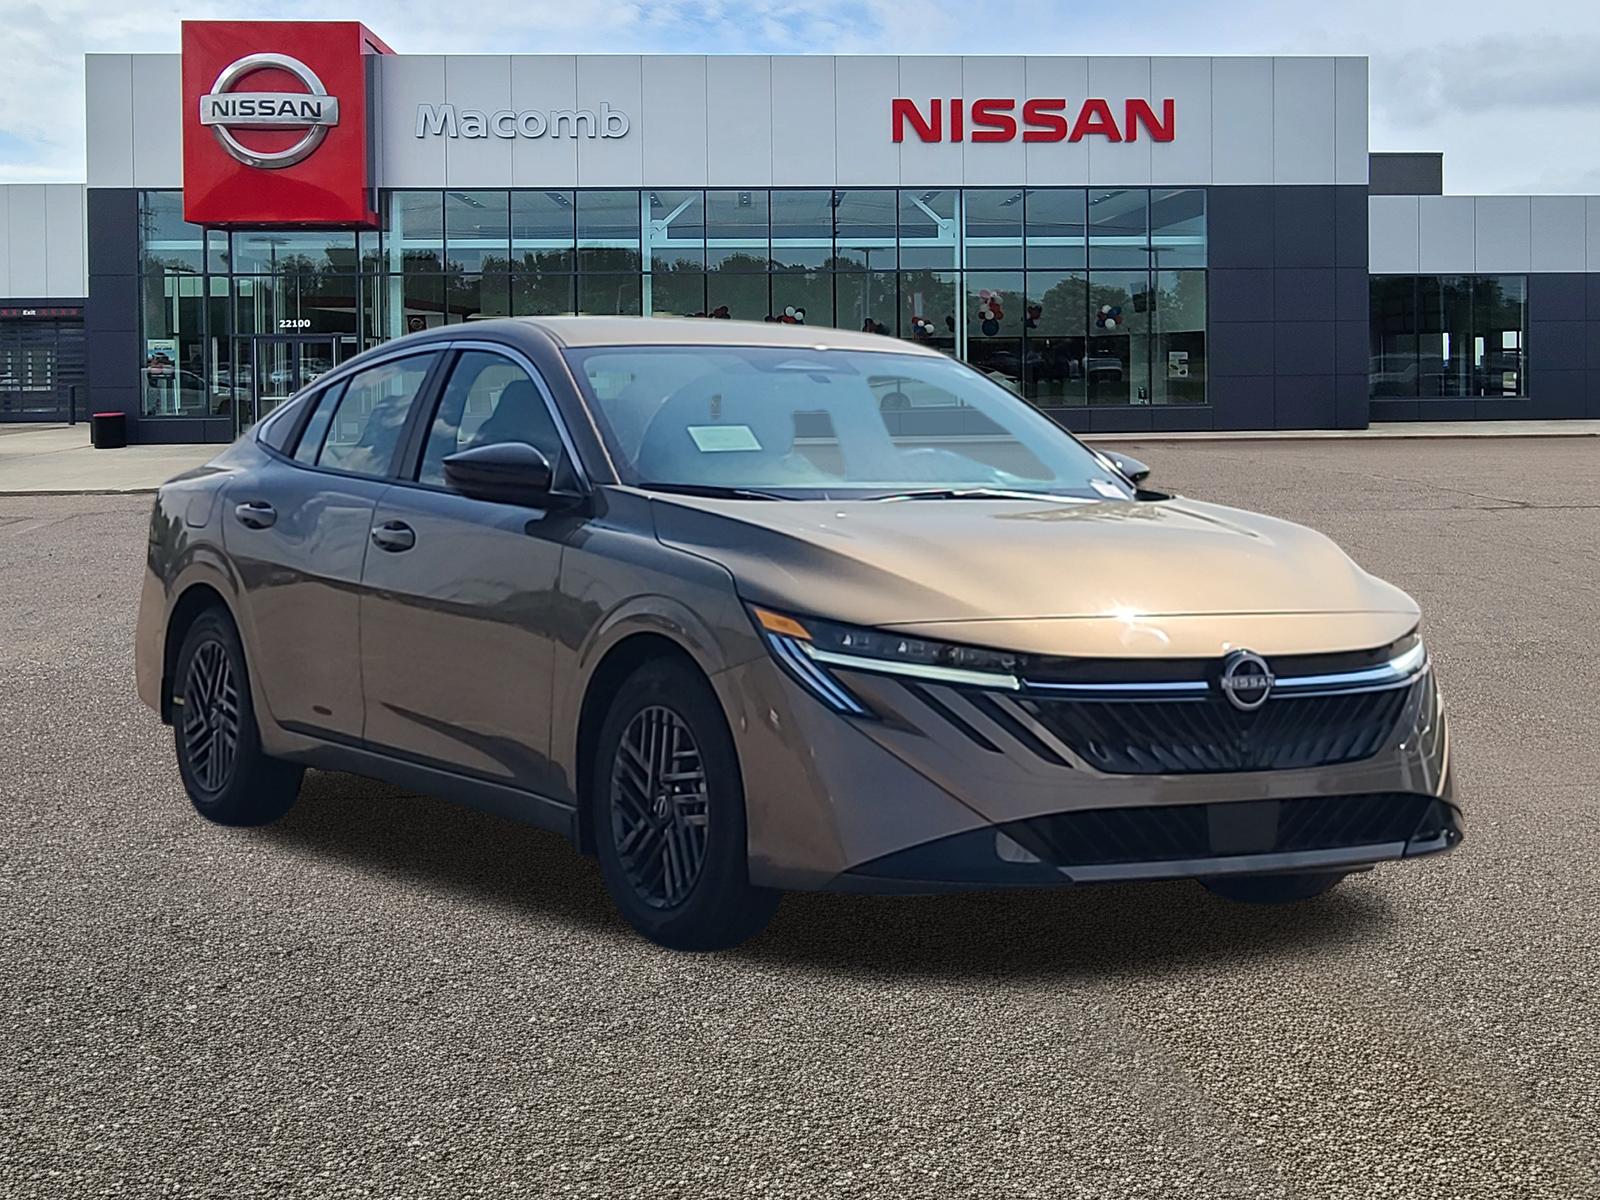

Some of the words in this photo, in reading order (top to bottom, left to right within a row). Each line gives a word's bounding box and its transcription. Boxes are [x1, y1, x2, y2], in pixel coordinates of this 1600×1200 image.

[211, 100, 322, 117] NISSAN
[415, 101, 630, 139] Macomb
[892, 98, 1175, 143] NISSAN
[279, 319, 311, 328] 22100
